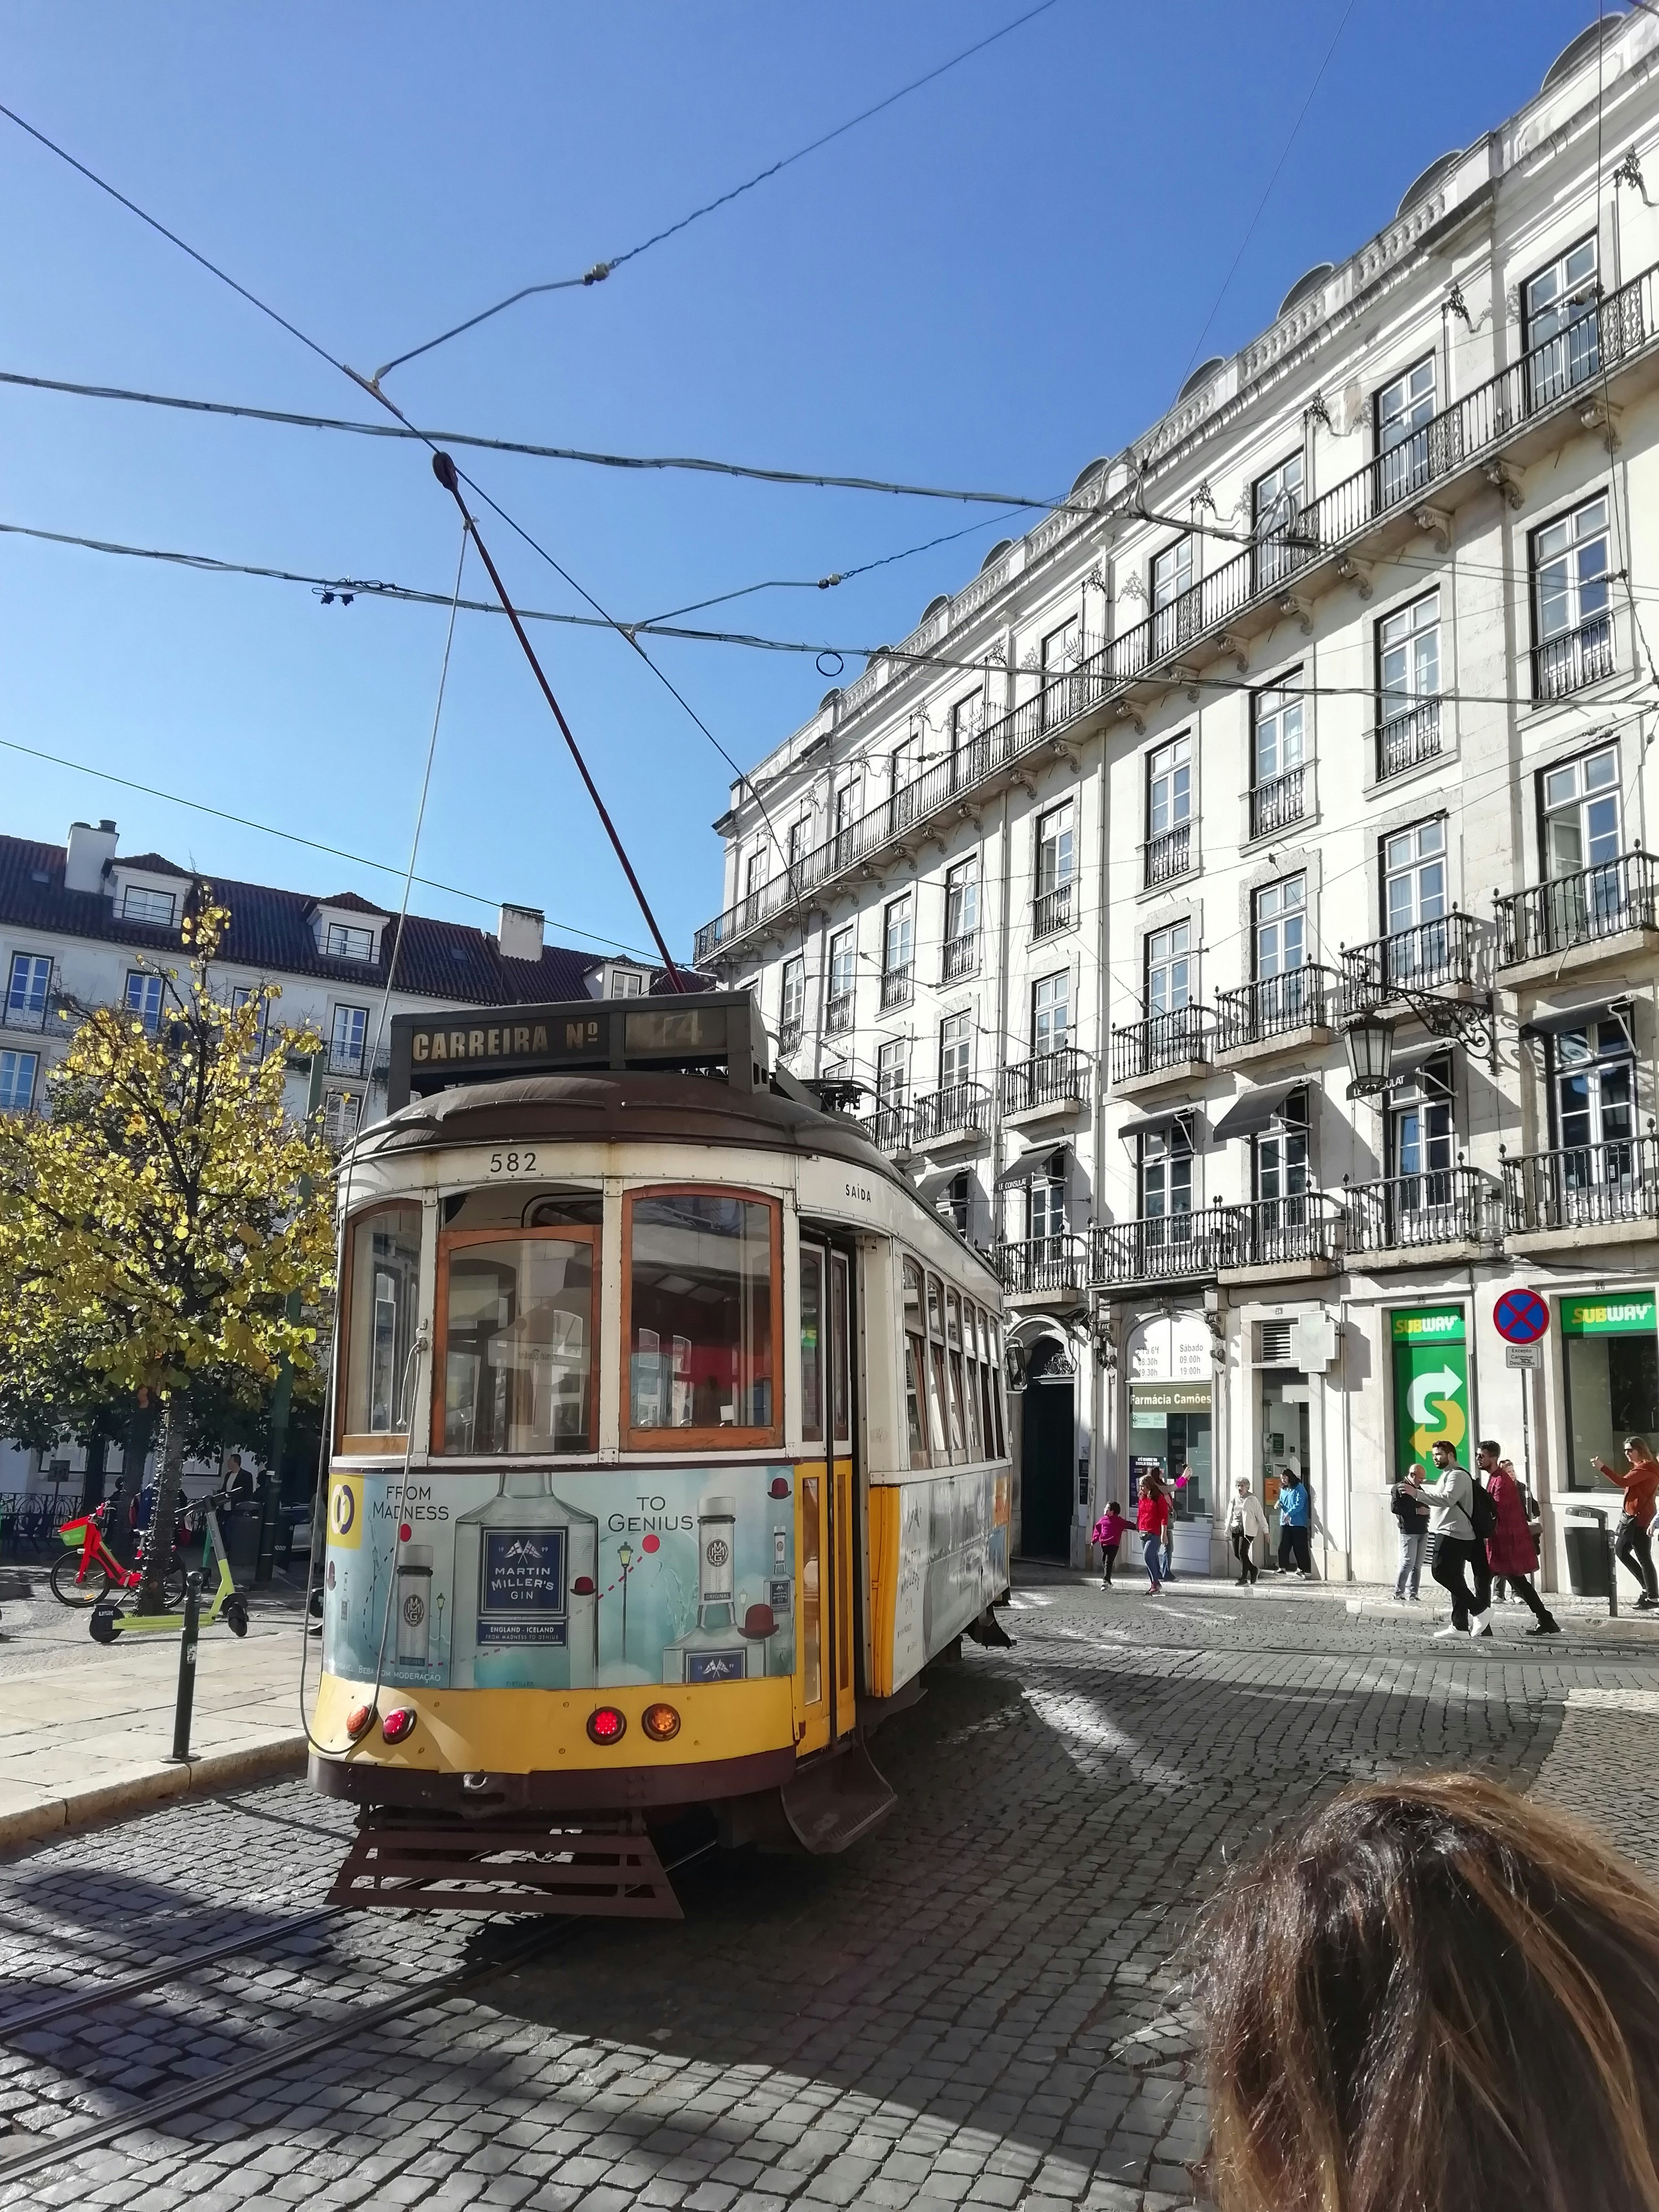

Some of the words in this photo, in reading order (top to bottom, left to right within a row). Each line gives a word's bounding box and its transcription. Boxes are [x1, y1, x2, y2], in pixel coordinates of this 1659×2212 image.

[413, 1025, 548, 1061] CARREIRA
[566, 1021, 598, 1050] Nº
[490, 1152, 536, 1172] 582
[1005, 1178, 1027, 1189] CONSULAT
[846, 1183, 871, 1203] SAÍDA
[1595, 1281, 1605, 1291] 26
[1418, 1295, 1426, 1304] 25
[1571, 1302, 1653, 1324] SUBWAY
[1394, 1314, 1459, 1334] SUBWAY
[1180, 1344, 1203, 1352] Sábado
[1130, 1394, 1171, 1405] Farmácia
[1174, 1393, 1211, 1404] Camões
[387, 1486, 431, 1501] FROM
[373, 1501, 449, 1520] MADNESS
[636, 1496, 666, 1511] TO
[608, 1513, 693, 1532] GENIUS
[491, 1578, 554, 1591] MILLER'S
[510, 1591, 533, 1600] GIN
[358, 1665, 374, 1674] BEBA
[394, 1671, 441, 1683] MODERAÇÃO
